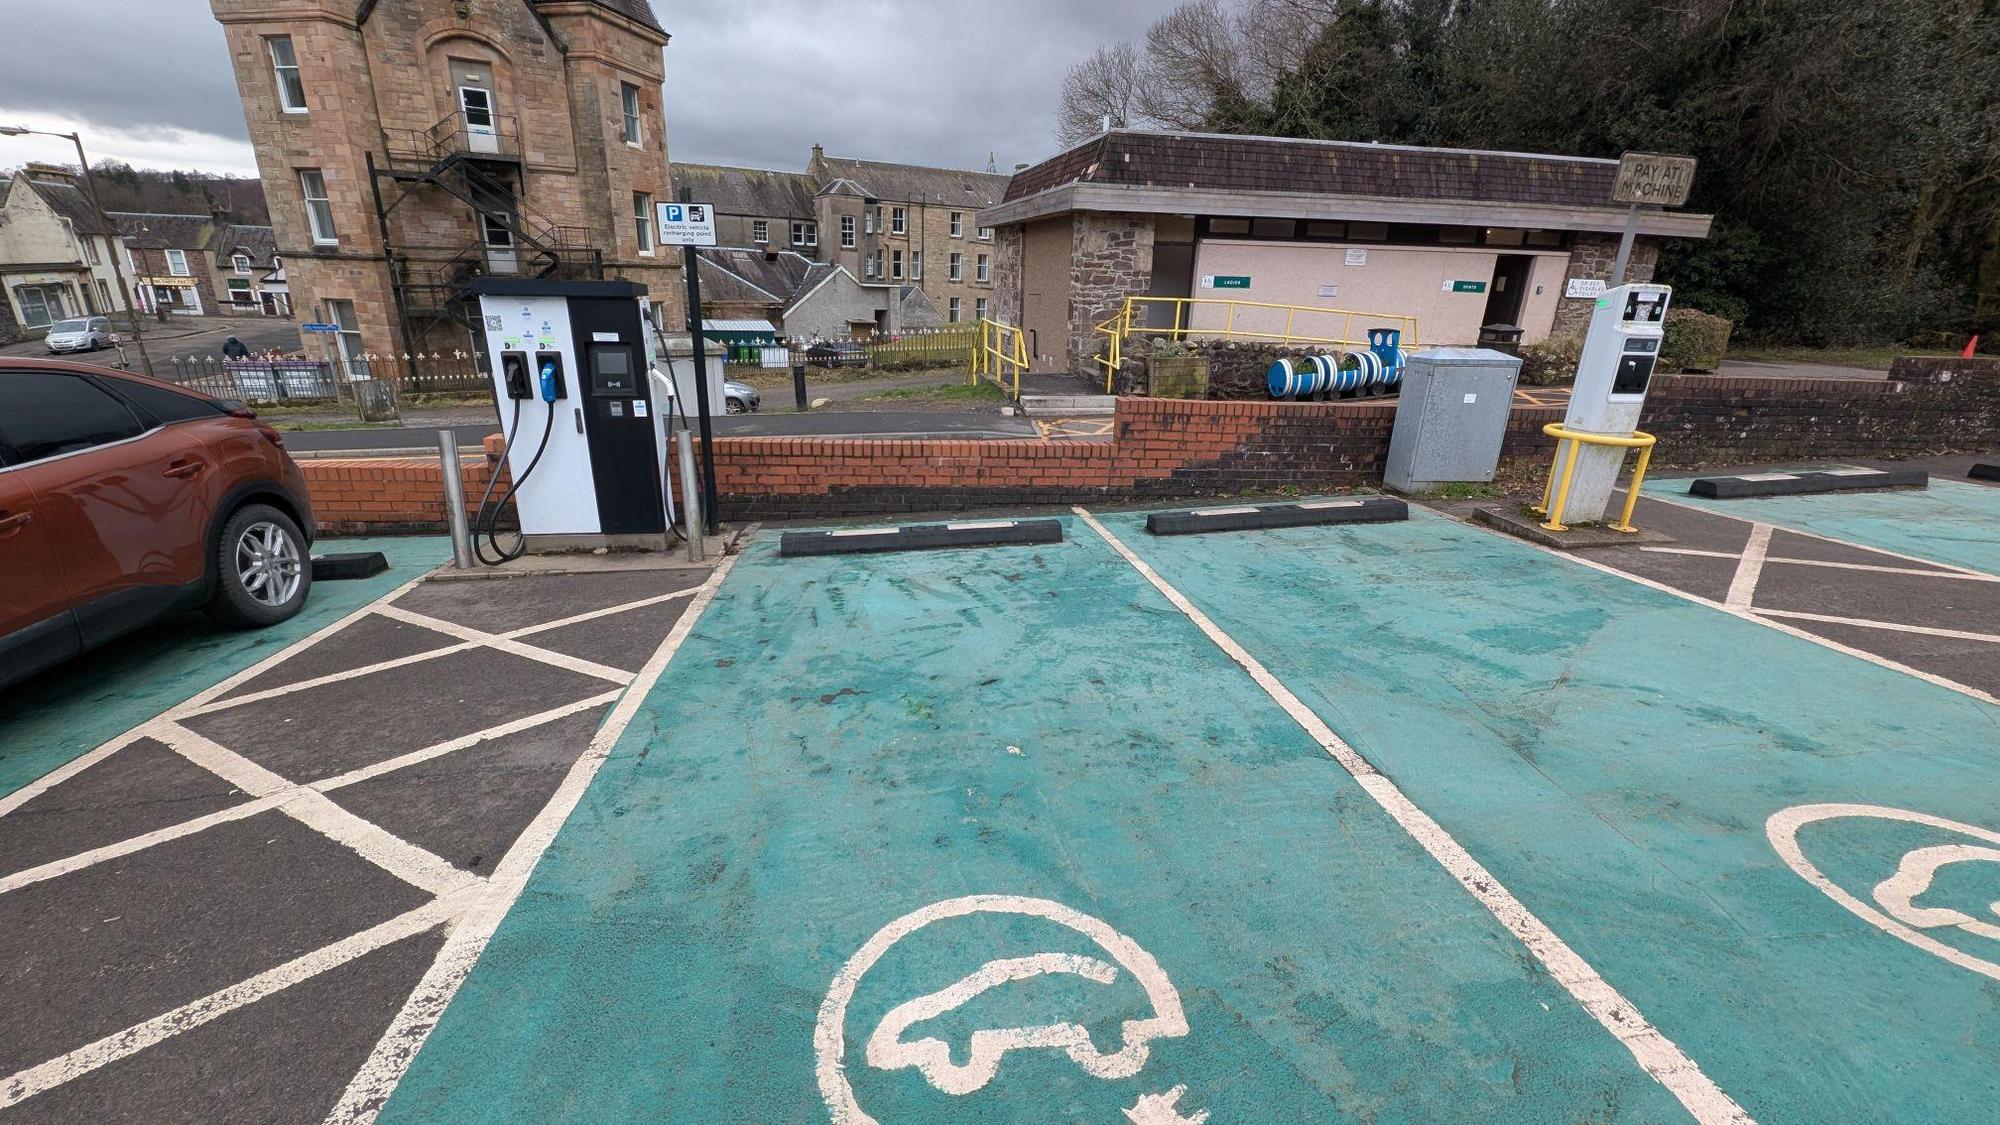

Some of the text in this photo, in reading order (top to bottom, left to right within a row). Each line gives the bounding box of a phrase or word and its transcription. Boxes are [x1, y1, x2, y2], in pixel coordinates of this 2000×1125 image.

[1633, 163, 1680, 180] PAY AT
[1621, 181, 1684, 198] MACHINE
[668, 207, 679, 220] P
[1625, 305, 1632, 313] A
[1655, 306, 1661, 315] B
